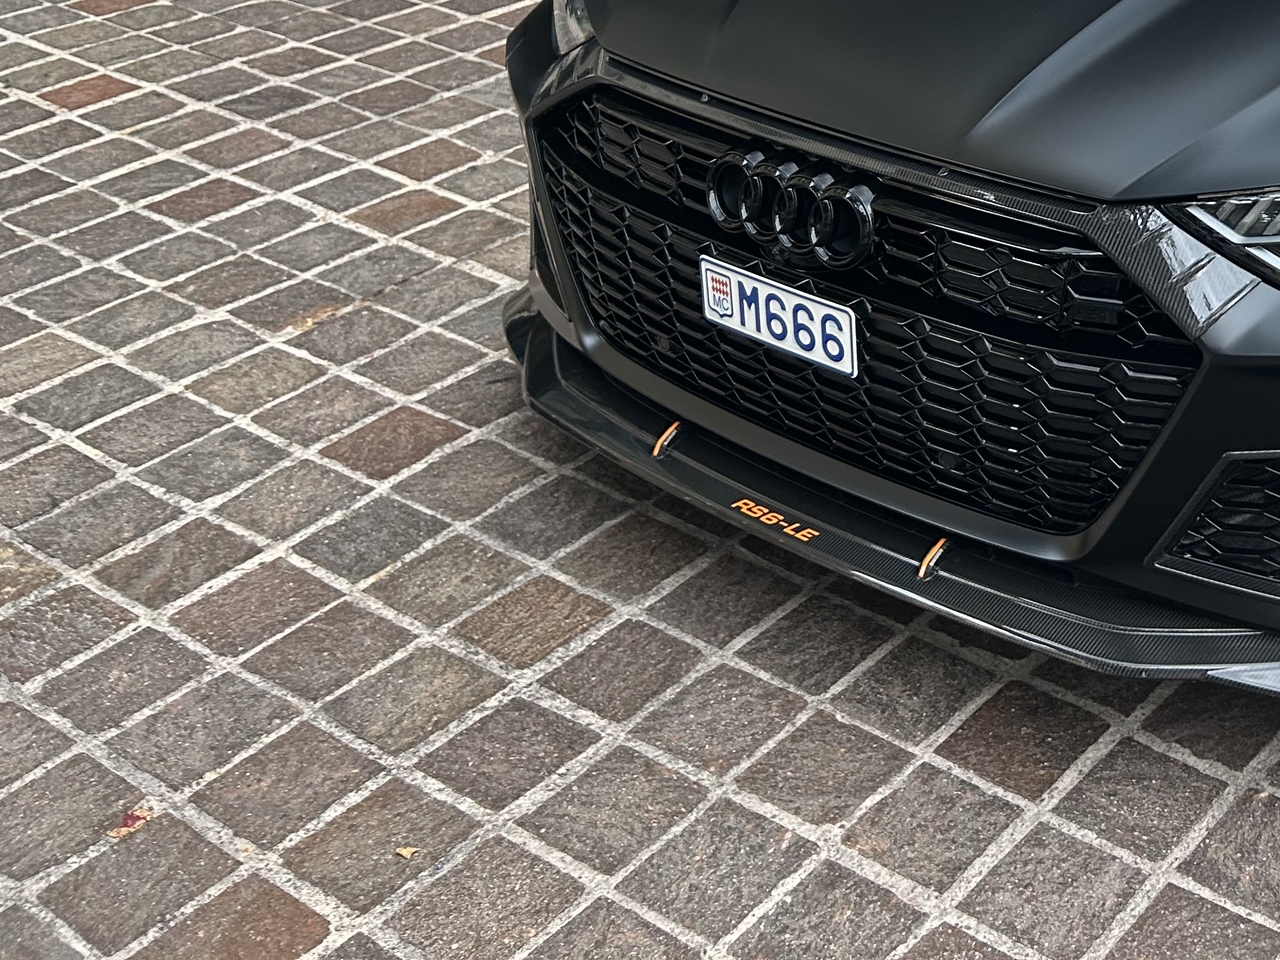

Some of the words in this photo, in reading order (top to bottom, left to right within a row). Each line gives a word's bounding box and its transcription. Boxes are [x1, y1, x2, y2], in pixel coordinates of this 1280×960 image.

[713, 293, 730, 311] MC
[737, 280, 845, 362] M666
[730, 499, 820, 542] RS6-LE
